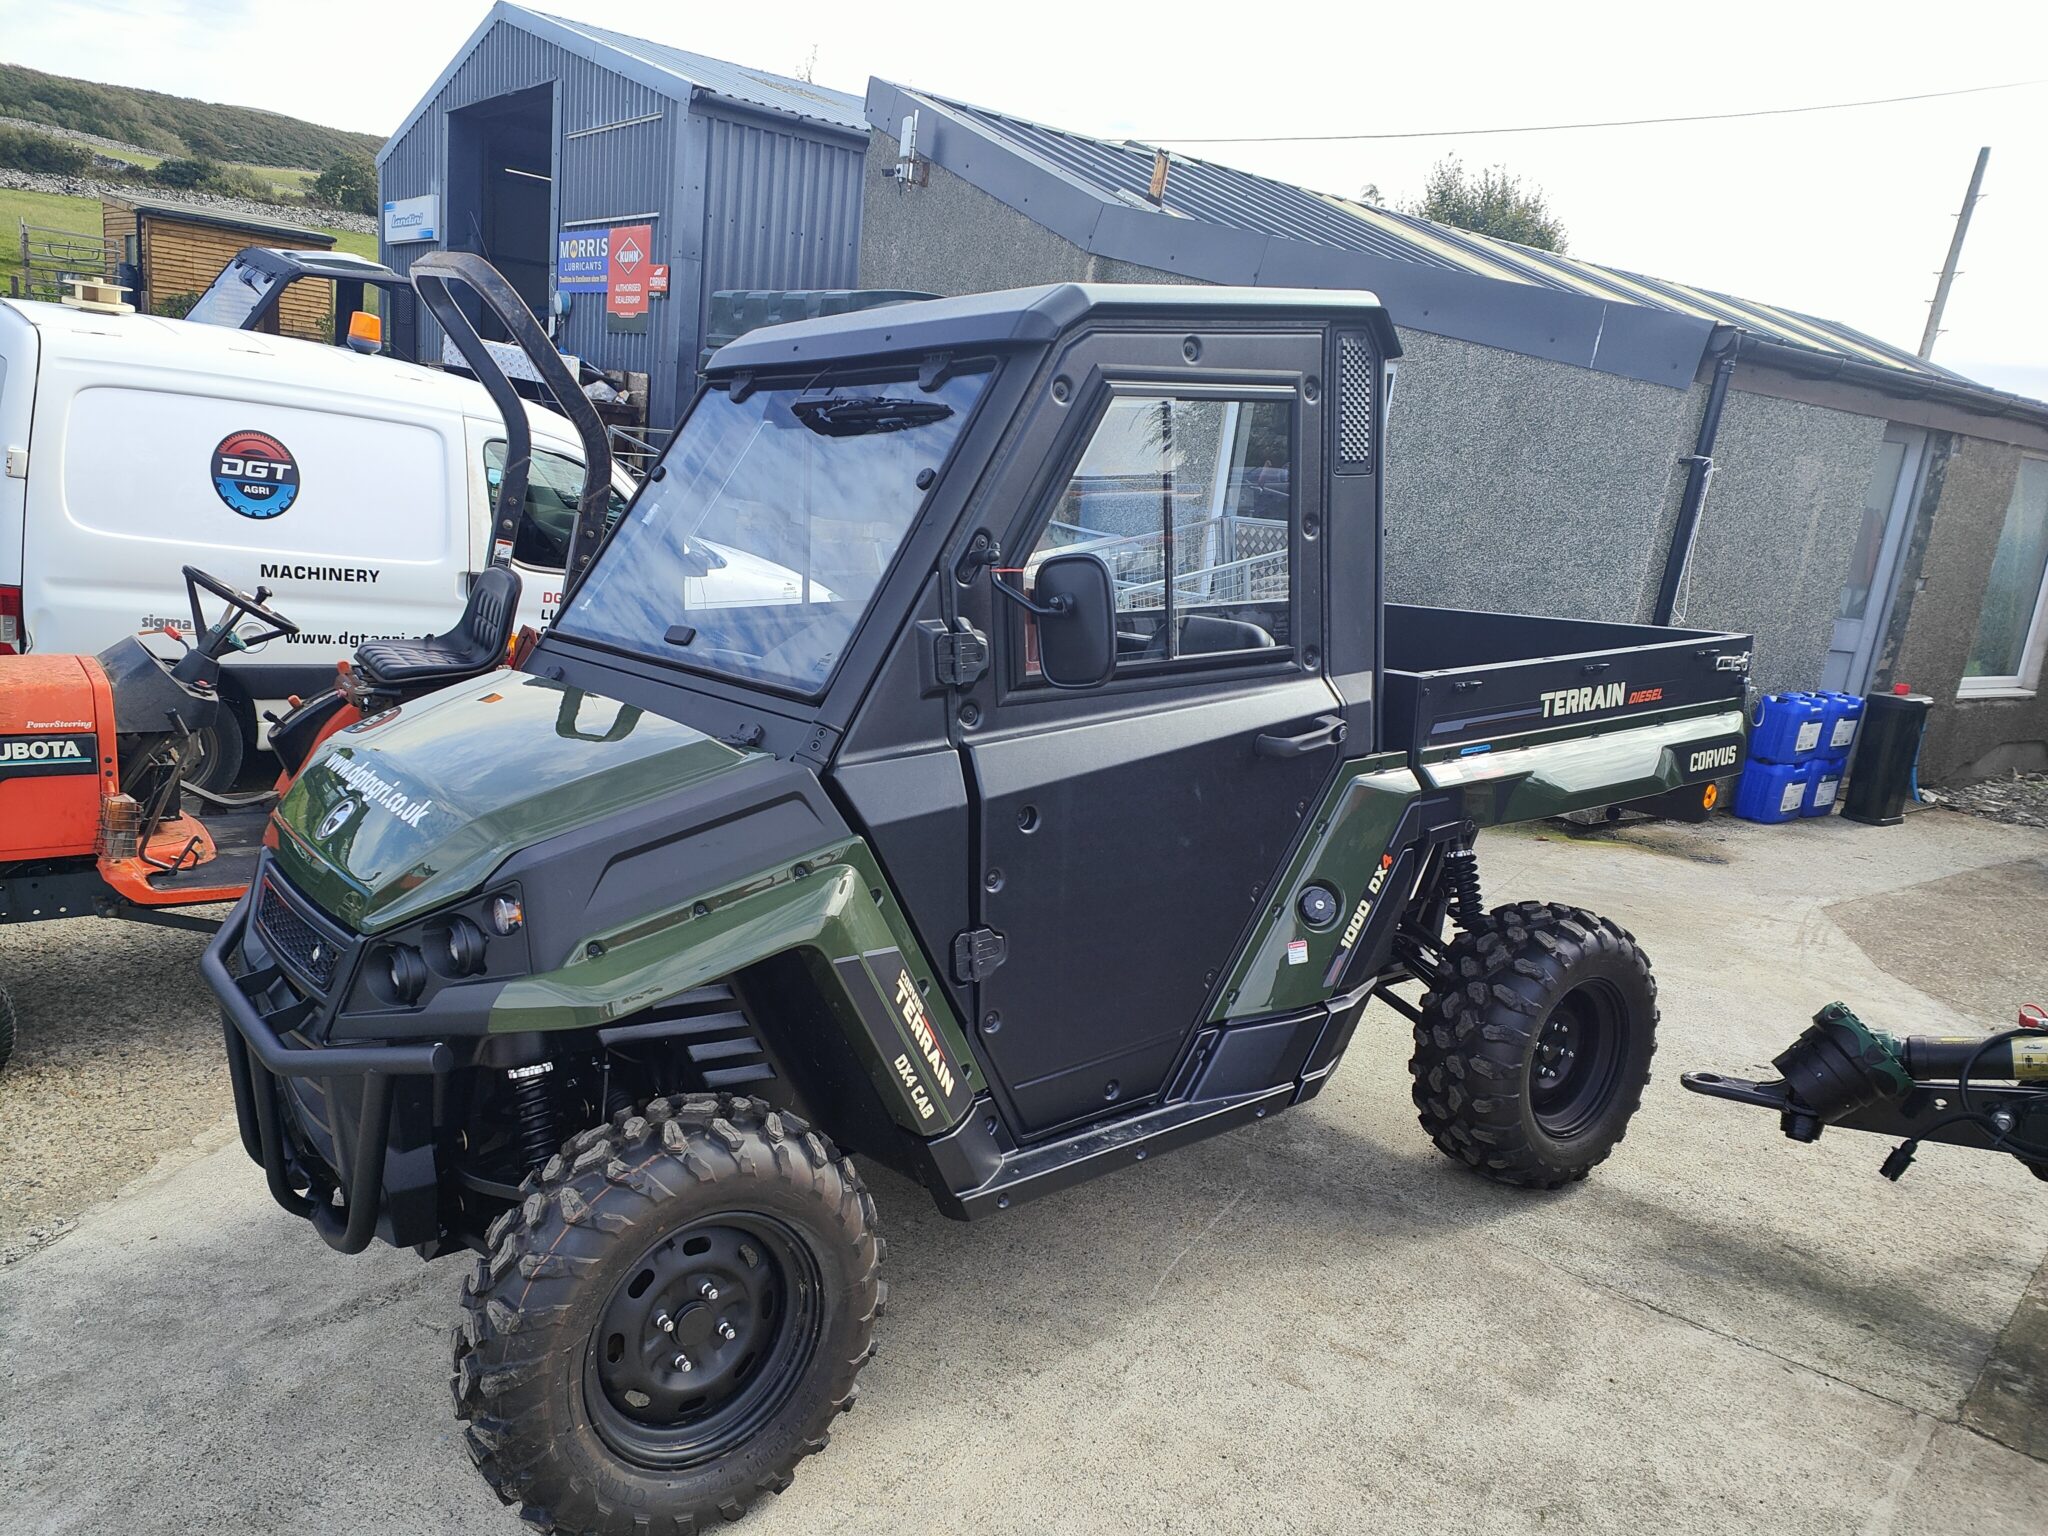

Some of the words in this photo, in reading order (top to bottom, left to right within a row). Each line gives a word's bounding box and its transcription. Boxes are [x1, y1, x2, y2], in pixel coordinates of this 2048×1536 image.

[560, 238, 608, 259] MORRIS
[620, 250, 639, 264] KUHN
[564, 261, 602, 272] LUBRICANTS
[615, 283, 642, 292] AUTHORISED
[649, 277, 667, 287] CORVUS
[615, 295, 641, 304] DEALERSHIP
[220, 457, 292, 480] DGT
[243, 485, 270, 495] AGRI
[260, 563, 380, 583] MACHINERY
[542, 592, 563, 604] DG
[141, 614, 192, 631] sigma
[1540, 681, 1626, 718] TERRAIN
[1628, 688, 1664, 705] DIESEL
[0, 741, 82, 761] UBOTA
[1689, 745, 1737, 773] CORVUS
[323, 752, 432, 828] www.dgtagri.co.uk
[1340, 899, 1371, 950] 1000
[1367, 853, 1393, 895] DX4
[900, 968, 924, 1015] CORVUS
[896, 978, 955, 1098] TERRAIN
[894, 1053, 918, 1089] DX4
[910, 1085, 935, 1120] CAB
